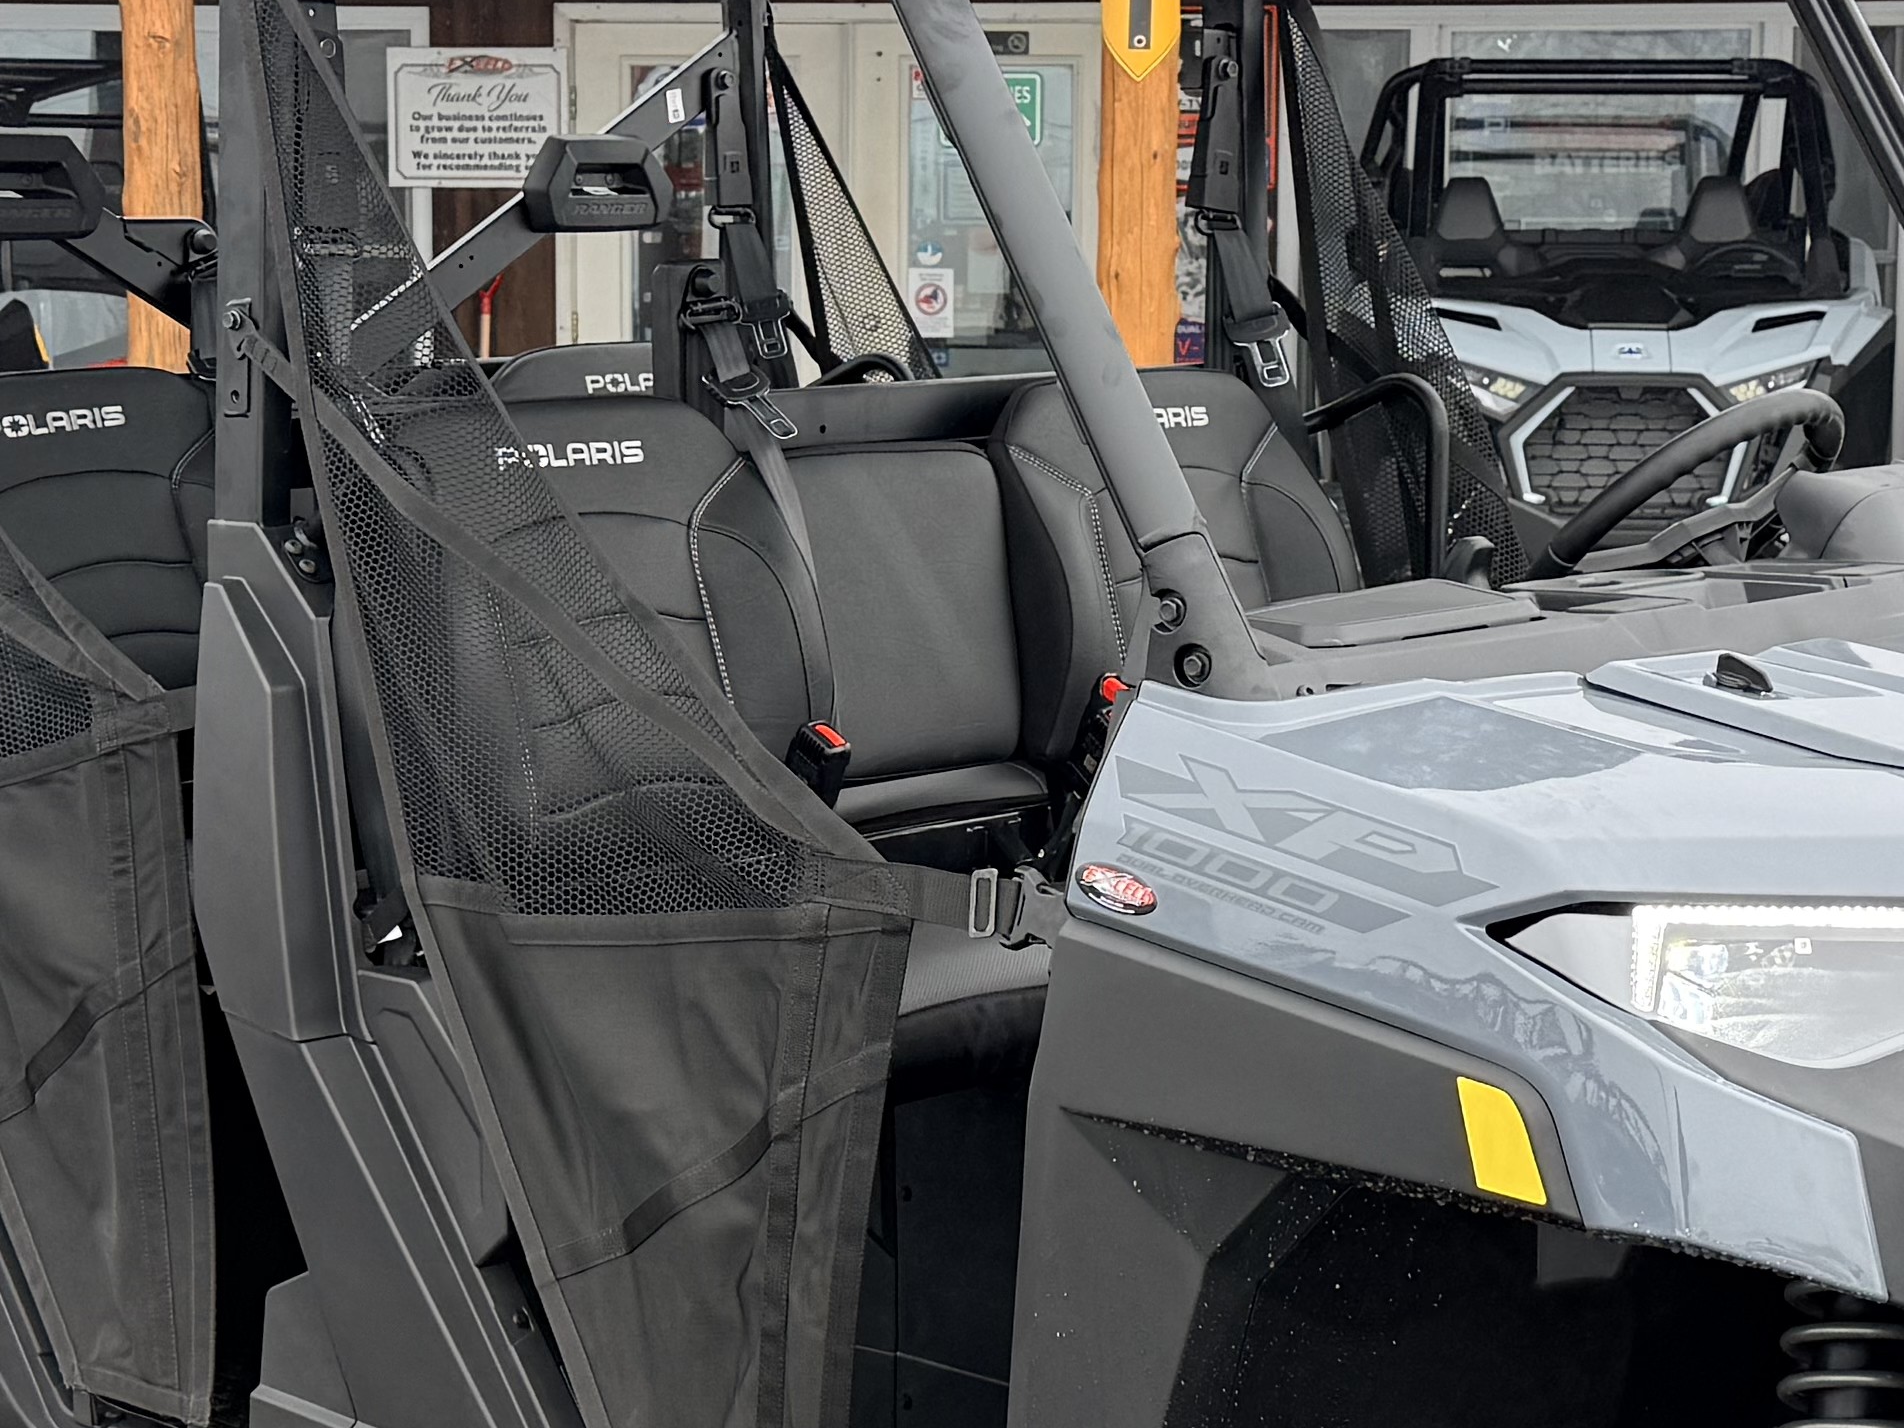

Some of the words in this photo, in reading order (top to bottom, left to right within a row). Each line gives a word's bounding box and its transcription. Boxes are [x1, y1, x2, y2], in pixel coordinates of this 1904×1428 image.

[427, 82, 483, 107] Thank
[487, 82, 530, 112] You
[411, 111, 434, 121] Our
[437, 112, 486, 121] business
[488, 112, 544, 121] continues
[409, 124, 421, 133] to
[424, 125, 454, 135] grow
[457, 124, 478, 133] due
[481, 124, 493, 133] to
[495, 124, 547, 133] referrals
[420, 134, 448, 144] from
[450, 135, 470, 144] our
[473, 136, 537, 144] customers.
[411, 150, 430, 160] We
[432, 150, 485, 161] sincerely
[488, 151, 521, 160] thank
[416, 162, 433, 171] for
[436, 162, 521, 173] recommending
[584, 372, 654, 394] POLA
[1153, 405, 1210, 429] ARIS
[494, 440, 645, 471] POLARIS
[1123, 753, 1465, 874] XP
[1118, 822, 1340, 914] 1000
[1082, 865, 1154, 907] EXCELL
[1169, 873, 1274, 917] OVERHEAD
